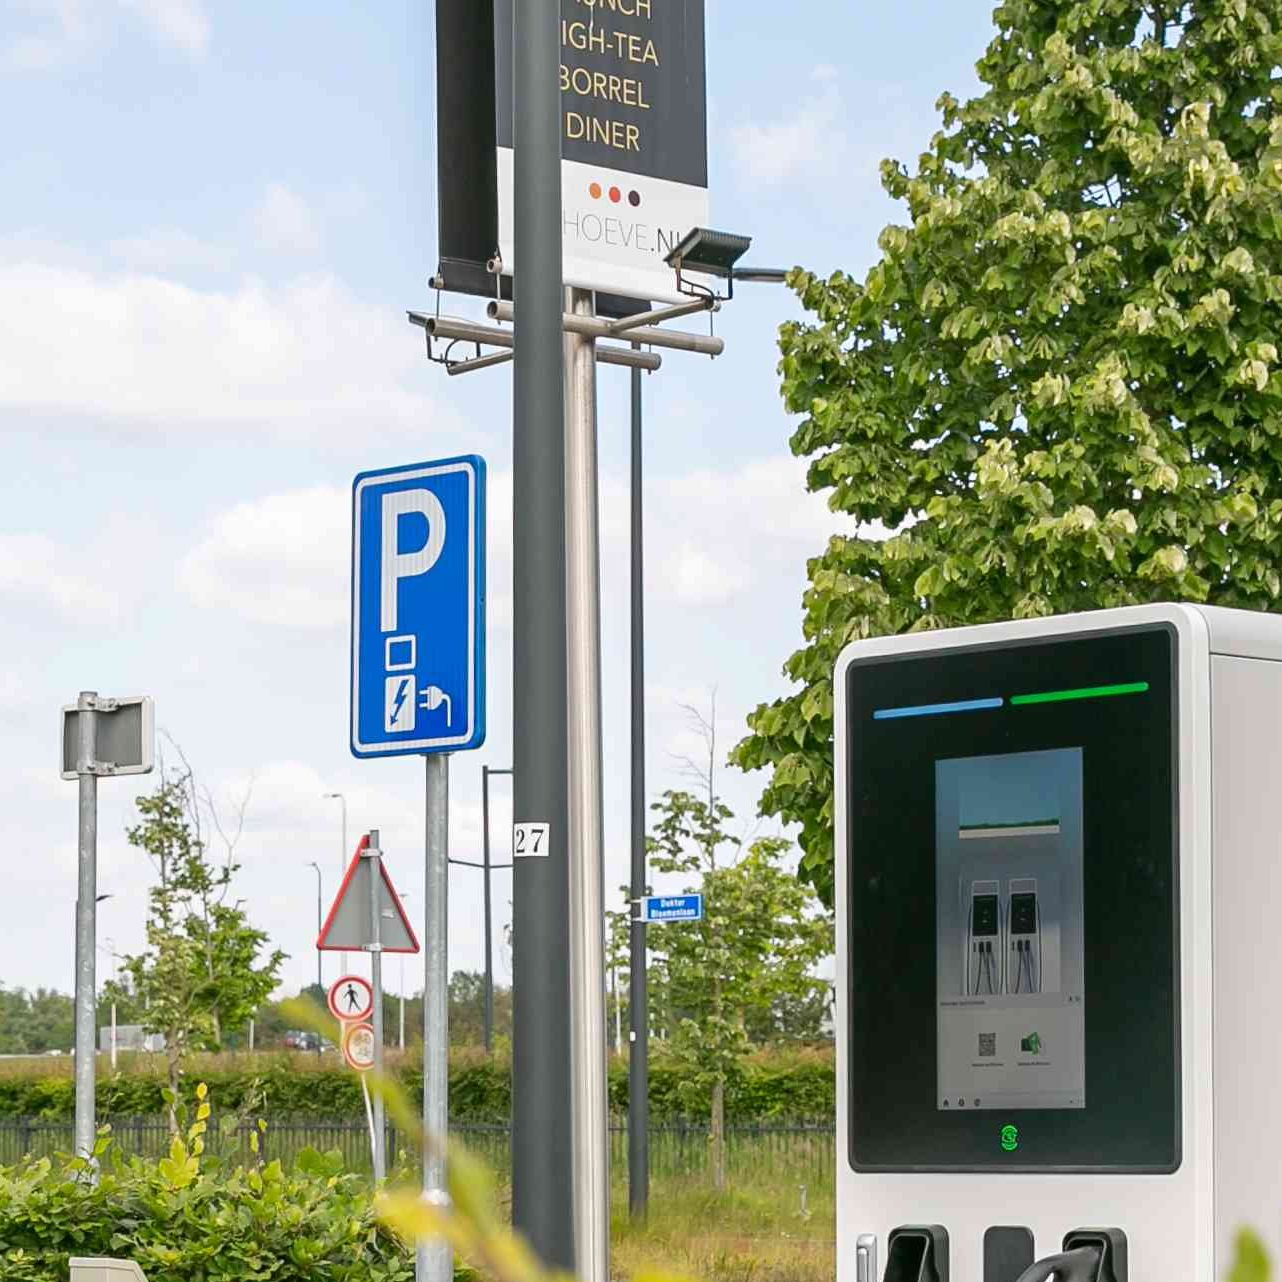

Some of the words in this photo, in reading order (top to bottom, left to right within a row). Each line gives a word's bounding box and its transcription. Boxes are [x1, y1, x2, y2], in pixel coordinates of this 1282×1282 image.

[561, 19, 659, 67] IGH-TEA
[566, 111, 640, 151] DINER
[380, 487, 447, 633] P
[516, 828, 544, 853] 27
